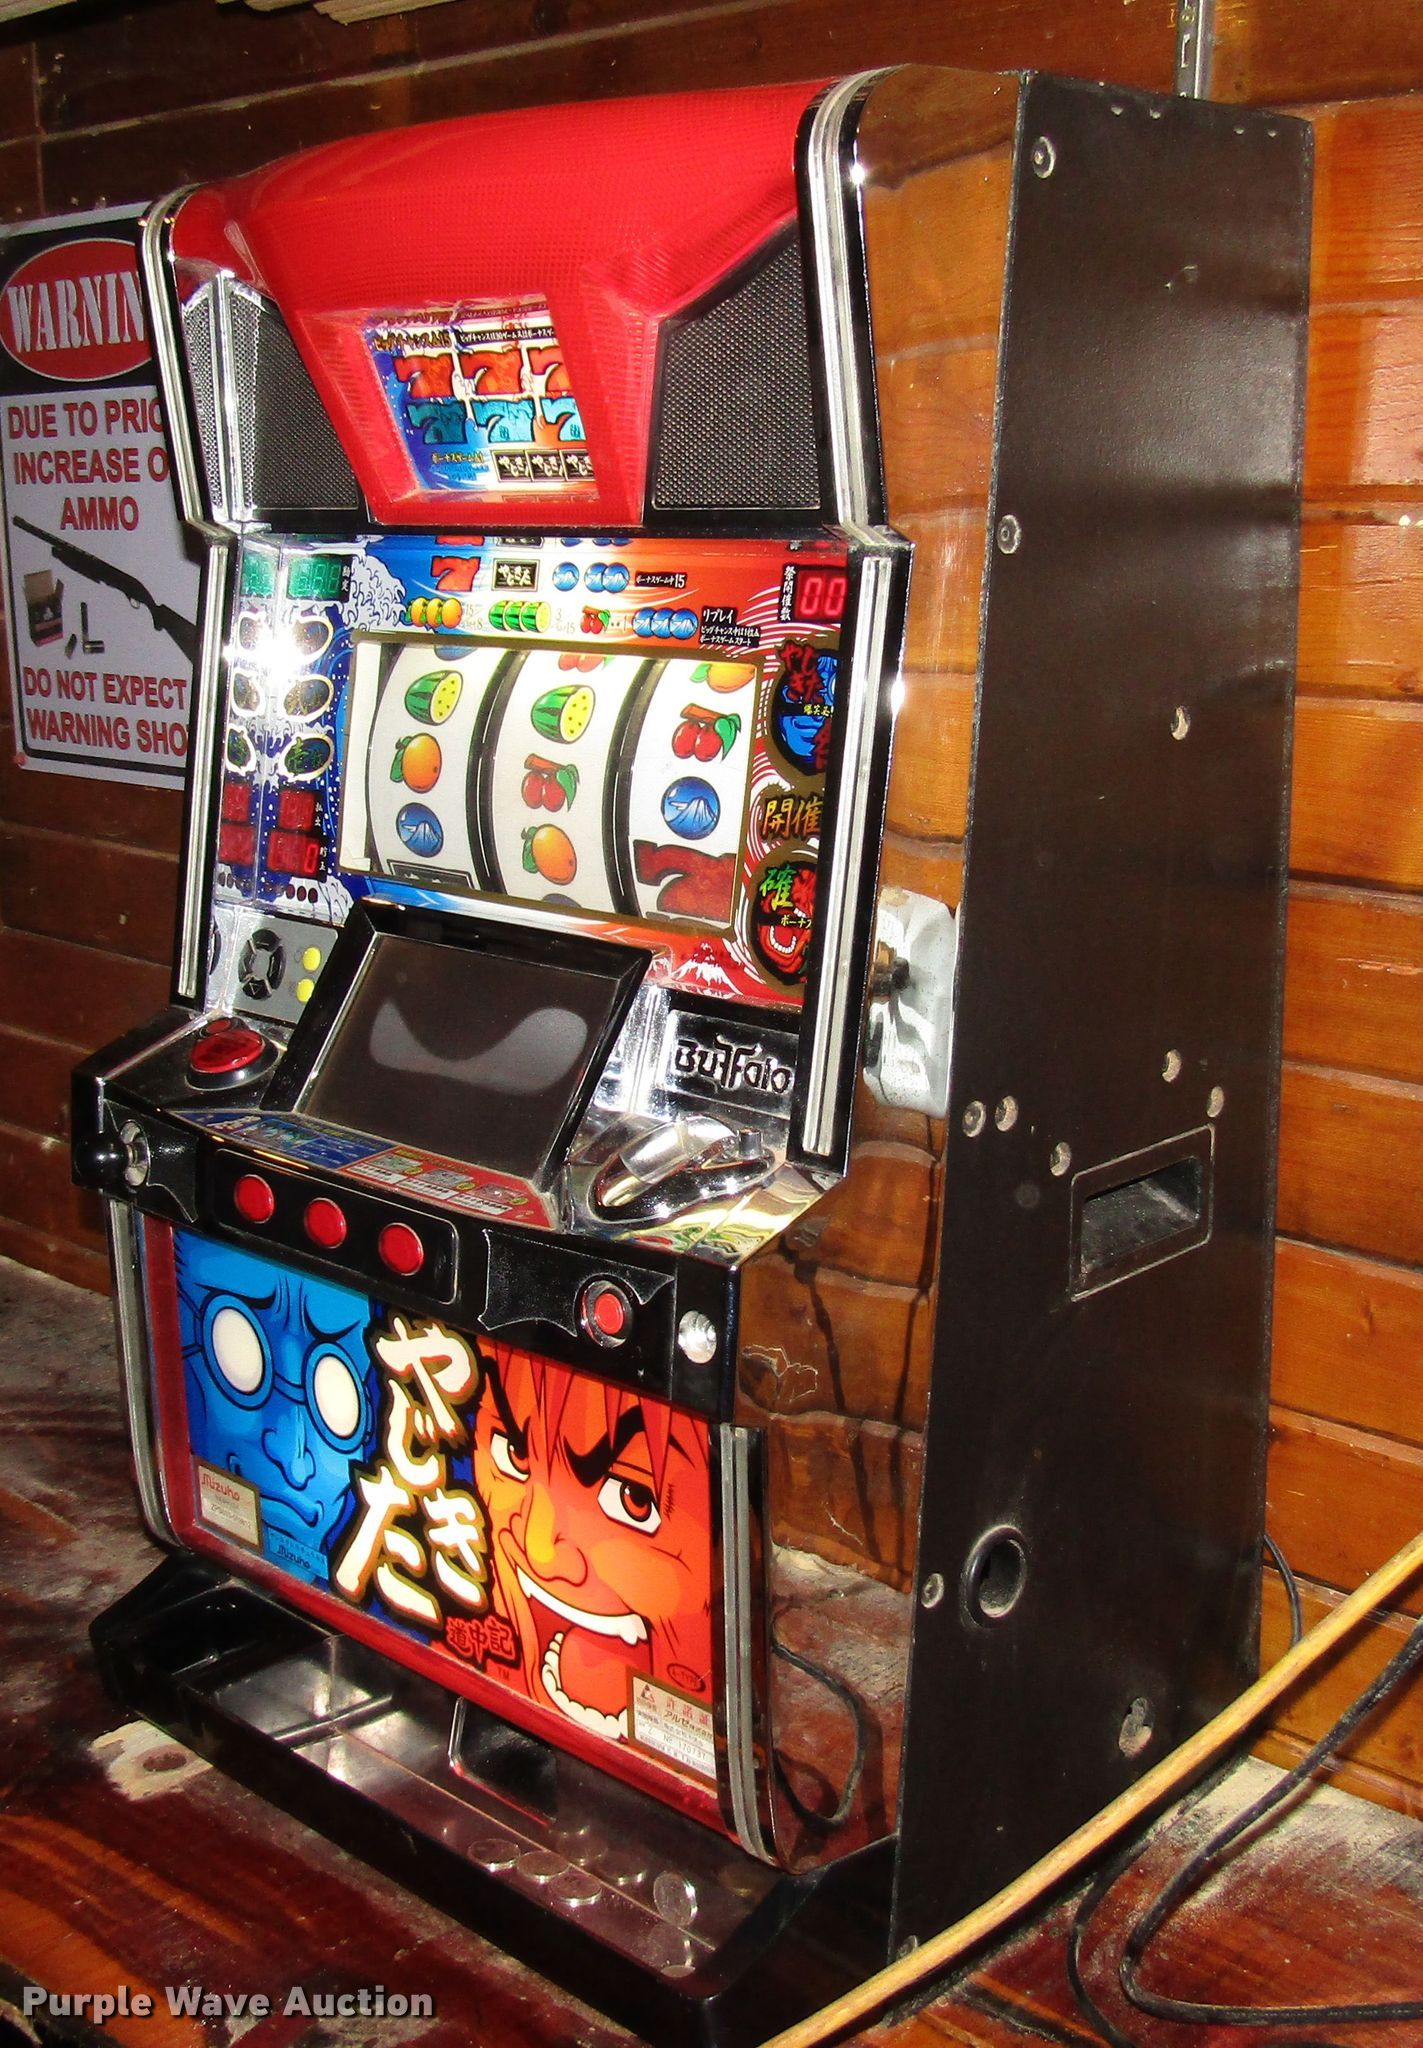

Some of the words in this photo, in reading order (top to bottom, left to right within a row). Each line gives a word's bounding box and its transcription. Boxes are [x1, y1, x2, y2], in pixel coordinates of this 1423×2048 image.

[8, 404, 58, 440] DUE
[63, 401, 98, 436] TO
[14, 448, 140, 485] INCREASE
[60, 496, 140, 531] AMMO
[703, 609, 733, 624] リプレイ
[23, 667, 51, 698] DO
[56, 670, 97, 701] NOT
[103, 673, 187, 709] EXPECT
[26, 708, 130, 750] WARNING
[136, 719, 189, 757] SHO
[446, 1616, 516, 1664] 道中記
